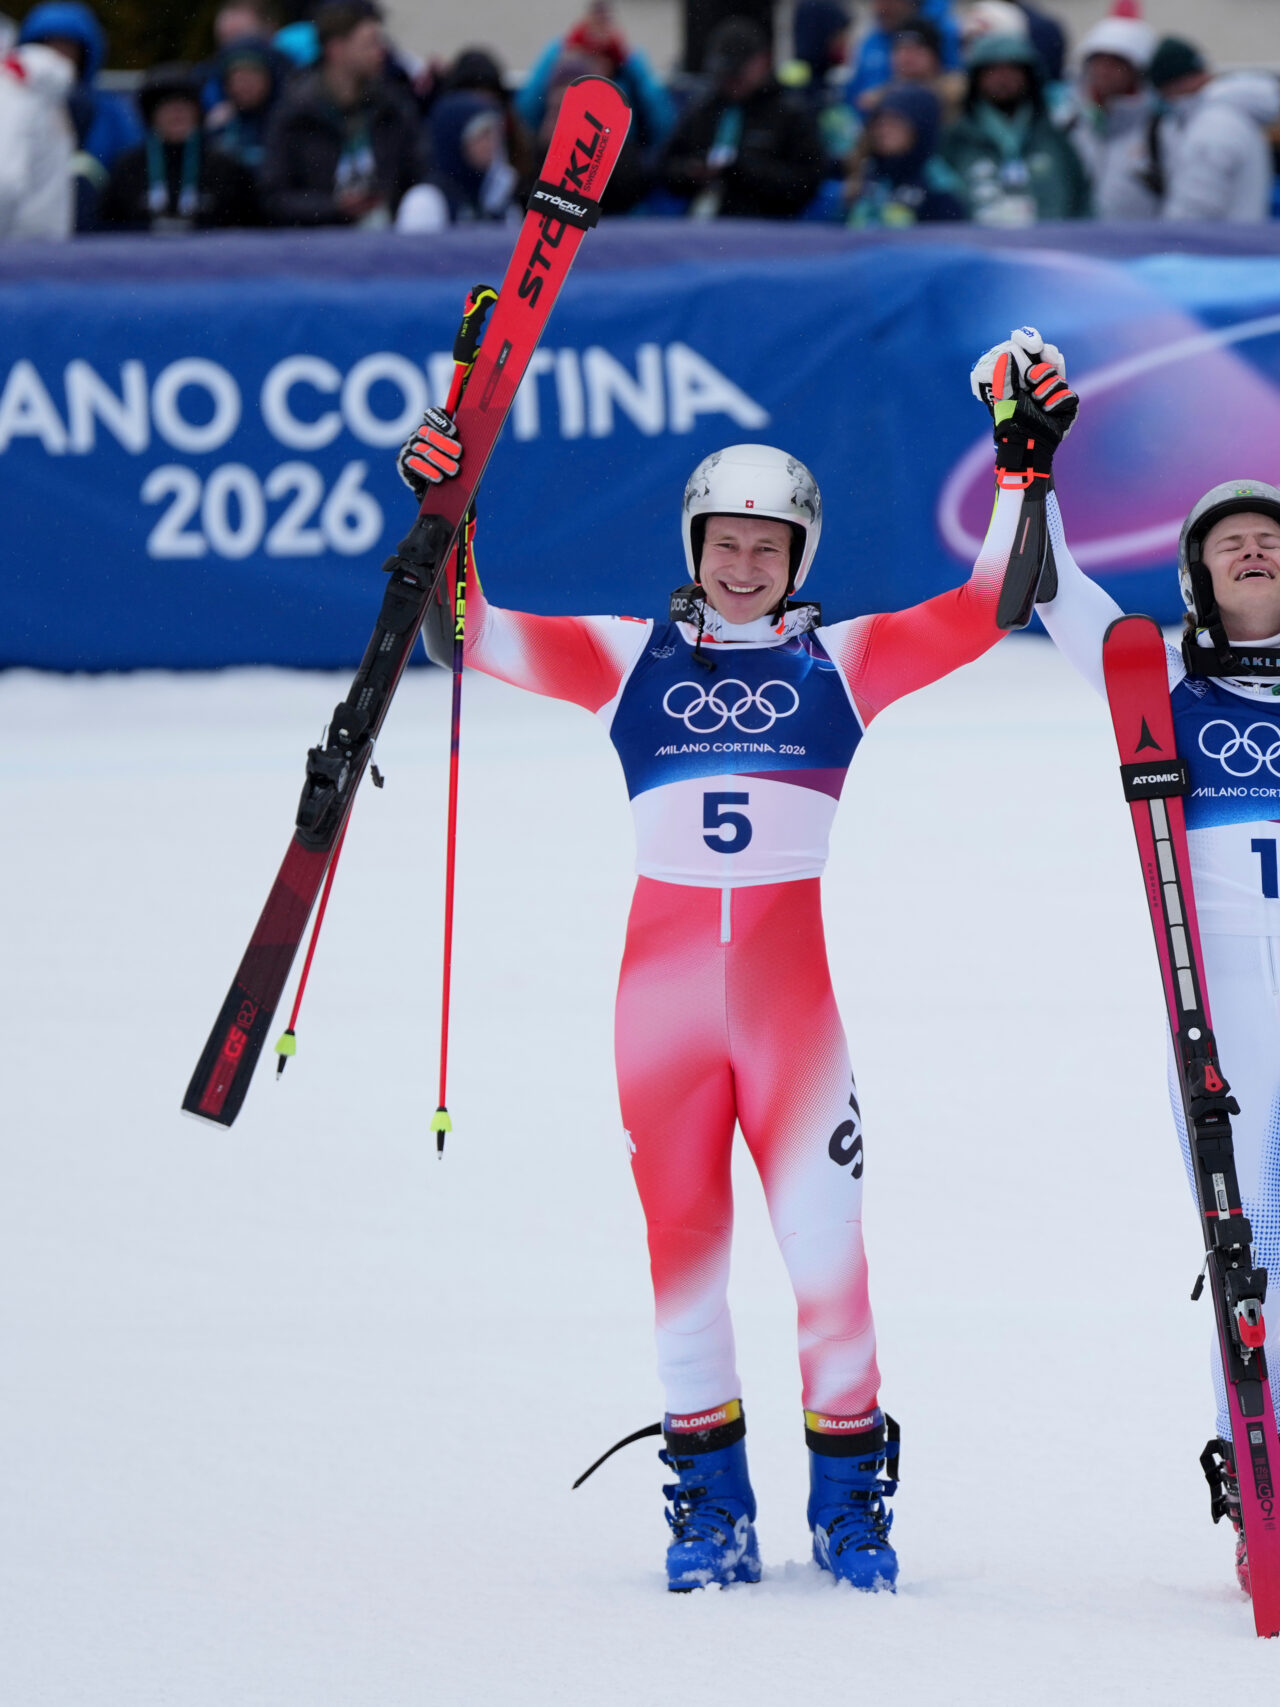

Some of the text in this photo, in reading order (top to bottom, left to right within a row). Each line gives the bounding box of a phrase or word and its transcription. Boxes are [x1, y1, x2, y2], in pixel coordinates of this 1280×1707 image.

[583, 135, 610, 191] SWISS MADE
[517, 110, 603, 309] STÖKLI
[534, 190, 588, 215] STÖCKLI
[140, 460, 385, 560] 2026
[455, 581, 467, 640] LEKI
[655, 743, 806, 756] MILANO CORTINA 2026
[1132, 773, 1180, 785] ATOMIC
[1191, 787, 1248, 797] MILANO
[702, 792, 753, 854] 5
[1250, 838, 1279, 898] 1
[236, 1000, 259, 1029] 182
[223, 1023, 248, 1058] GS
[671, 1410, 726, 1428] SALOMON
[817, 1415, 874, 1429] SALOMON
